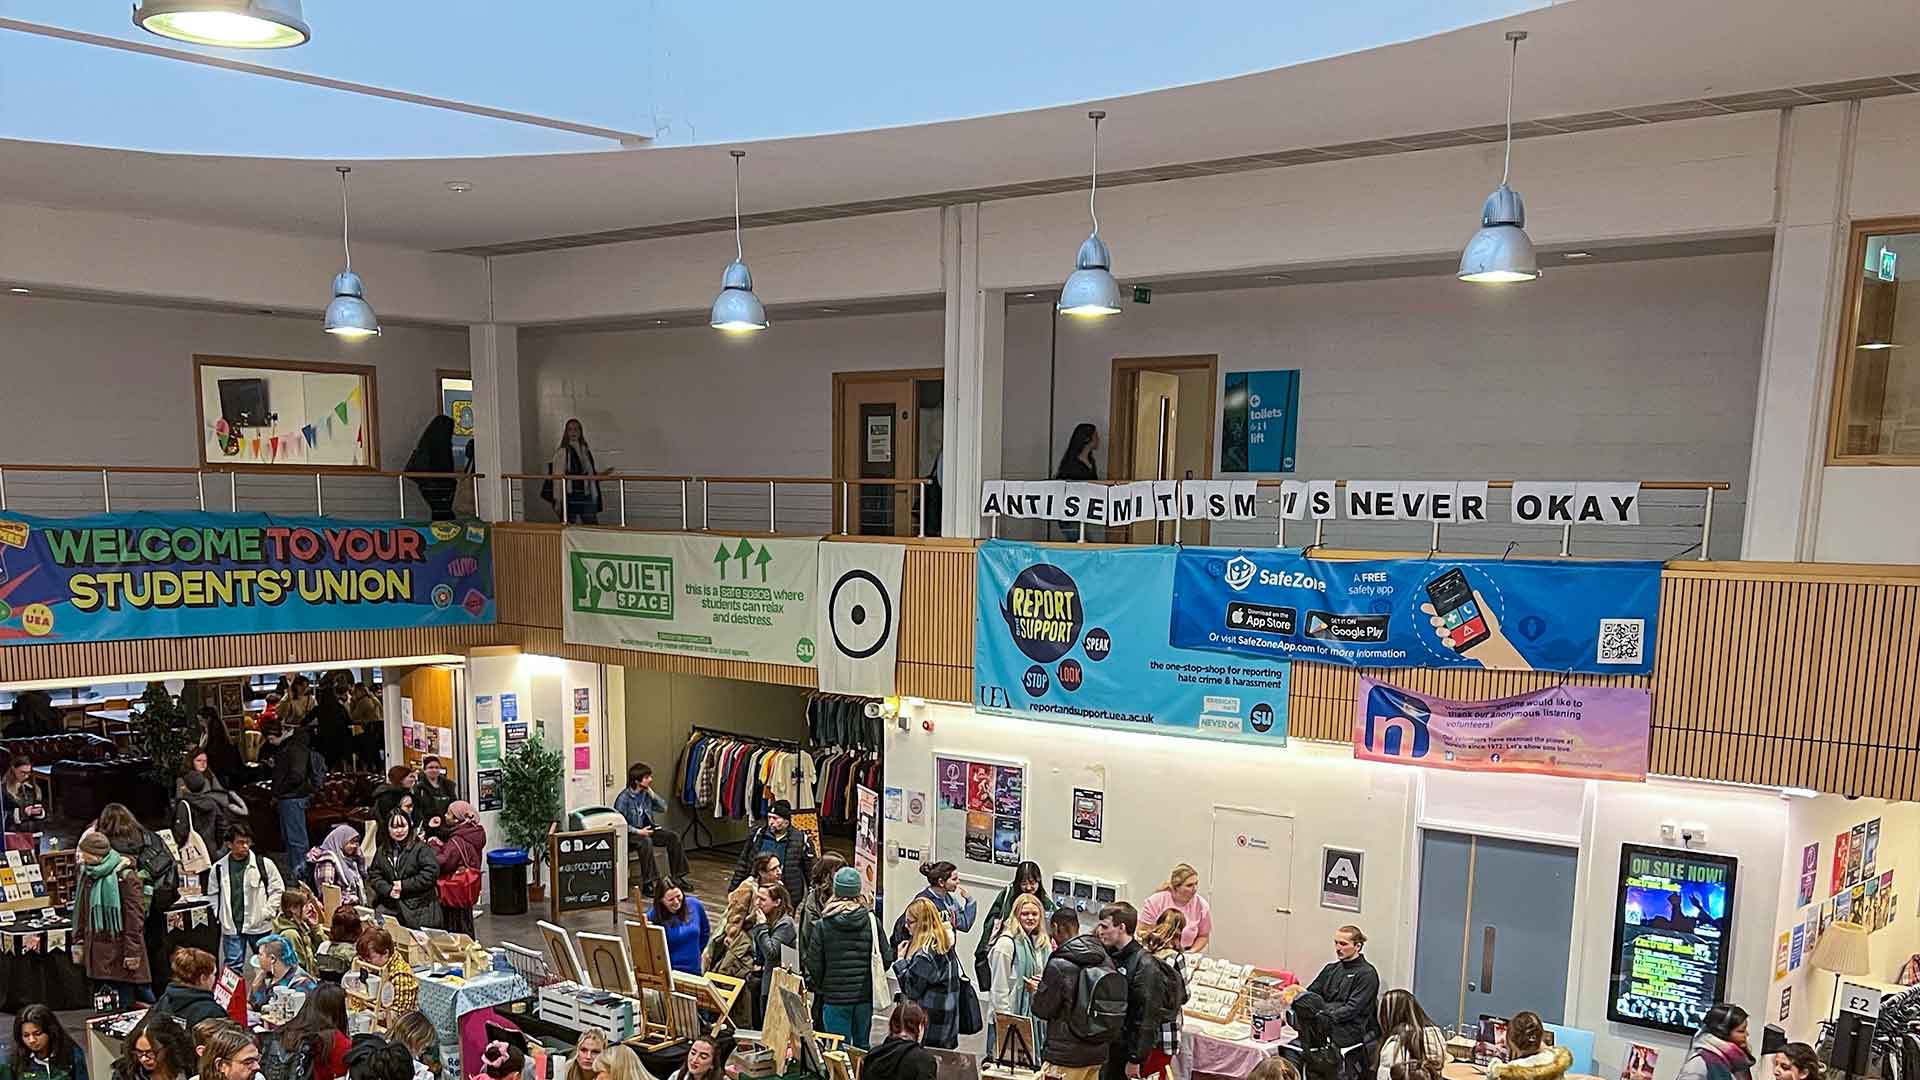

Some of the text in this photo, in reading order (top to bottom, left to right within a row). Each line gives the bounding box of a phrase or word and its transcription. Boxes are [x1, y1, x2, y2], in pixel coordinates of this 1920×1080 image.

[1250, 408, 1282, 420] toilets
[1250, 432, 1264, 444] lift
[984, 491, 1257, 523] ANTISEMITISM
[1350, 491, 1487, 521] NEVER
[1516, 494, 1636, 522] OKAY
[45, 526, 263, 566] WELCOME
[266, 527, 320, 563] TO
[325, 527, 426, 562] YOUR
[596, 560, 670, 593] QUIET
[1353, 572, 1387, 583] A FREE
[299, 567, 412, 603] UNION
[685, 583, 805, 602] this is a safe space where
[1348, 584, 1394, 596] safety app
[617, 592, 670, 611] SPACE
[701, 598, 784, 614] students can relax
[1013, 587, 1074, 620] REPORT
[712, 612, 730, 624] and
[1247, 608, 1271, 616] Download
[25, 614, 50, 627] UEA
[1245, 615, 1291, 630] App Store
[1019, 618, 1074, 643] SUPPORT
[1330, 624, 1365, 640] Google
[797, 643, 814, 656] SU
[1085, 637, 1110, 651] SPEAK
[1208, 632, 1220, 642] Or
[1221, 634, 1237, 645] visit
[1238, 635, 1316, 655] SafeZoneApp.com
[1317, 645, 1329, 655] for
[1330, 648, 1355, 658] more
[1059, 666, 1081, 684] LOOK
[1149, 661, 1282, 679] the one-stop-shop for reporting
[1025, 672, 1048, 689] STOP
[1178, 673, 1197, 683] hate
[1198, 675, 1223, 685] crime
[1232, 677, 1282, 689] harassment
[980, 685, 1012, 709] UEA
[1556, 697, 1571, 707] like
[1573, 698, 1583, 708] to
[1029, 702, 1154, 724] reportandsupport.uea.ac.uk
[1252, 710, 1273, 726] SU
[1543, 709, 1581, 721] listening
[1201, 718, 1227, 728] NEVER
[1328, 857, 1358, 882] A
[1631, 858, 1650, 874] ON
[1653, 861, 1685, 880] SALE
[1687, 865, 1724, 883] NOW!
[1849, 998, 1870, 1012] £2
